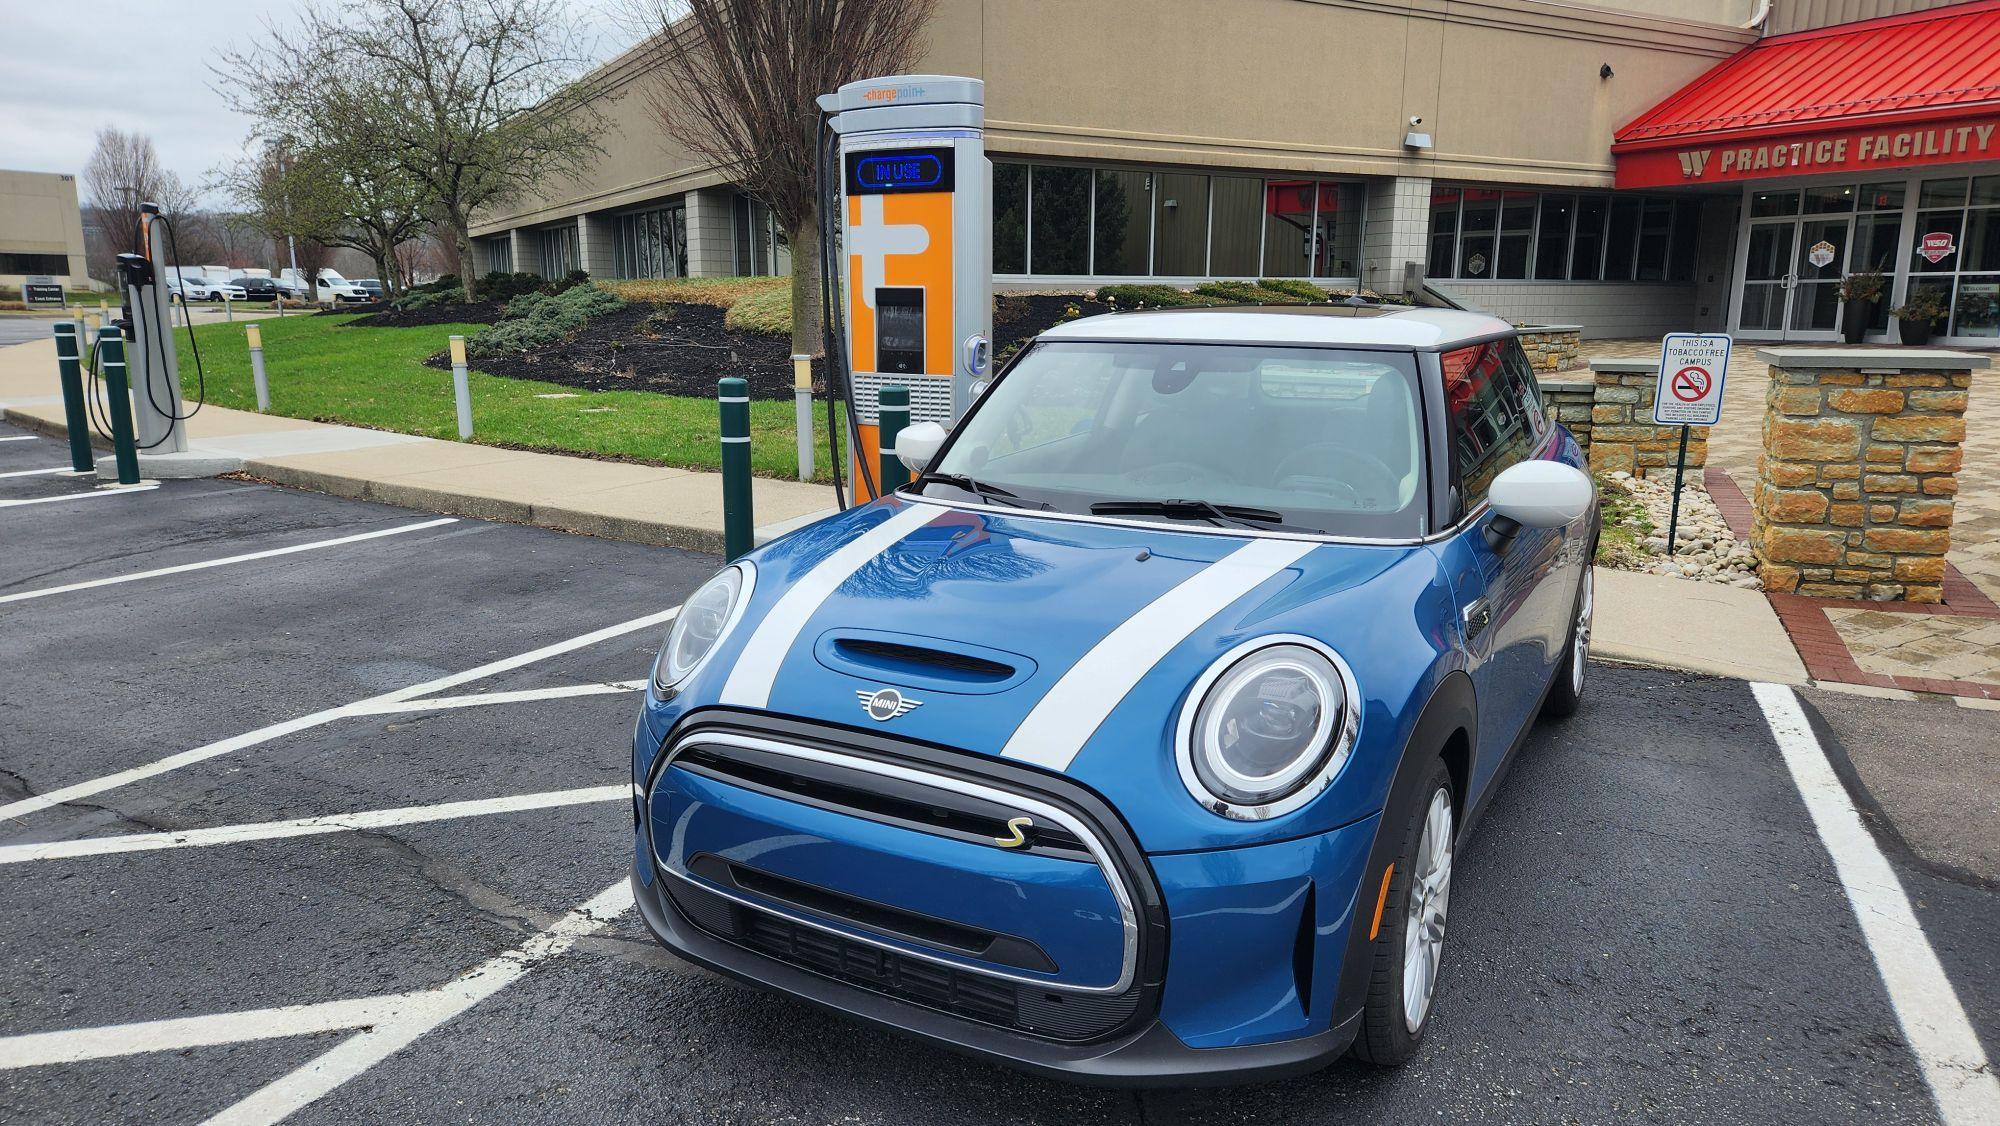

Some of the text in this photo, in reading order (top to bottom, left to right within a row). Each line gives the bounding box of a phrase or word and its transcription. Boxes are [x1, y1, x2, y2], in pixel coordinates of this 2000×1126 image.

[1720, 138, 1848, 173] PRACTICE
[1858, 124, 1996, 160] FACILITY
[876, 162, 921, 181] IN USE
[1682, 339, 1714, 347] THIS IS A
[1669, 348, 1725, 357] TOBACCO FREE
[1679, 358, 1712, 366] CAMPUS
[872, 697, 897, 710] MINI
[995, 817, 1033, 847] S
